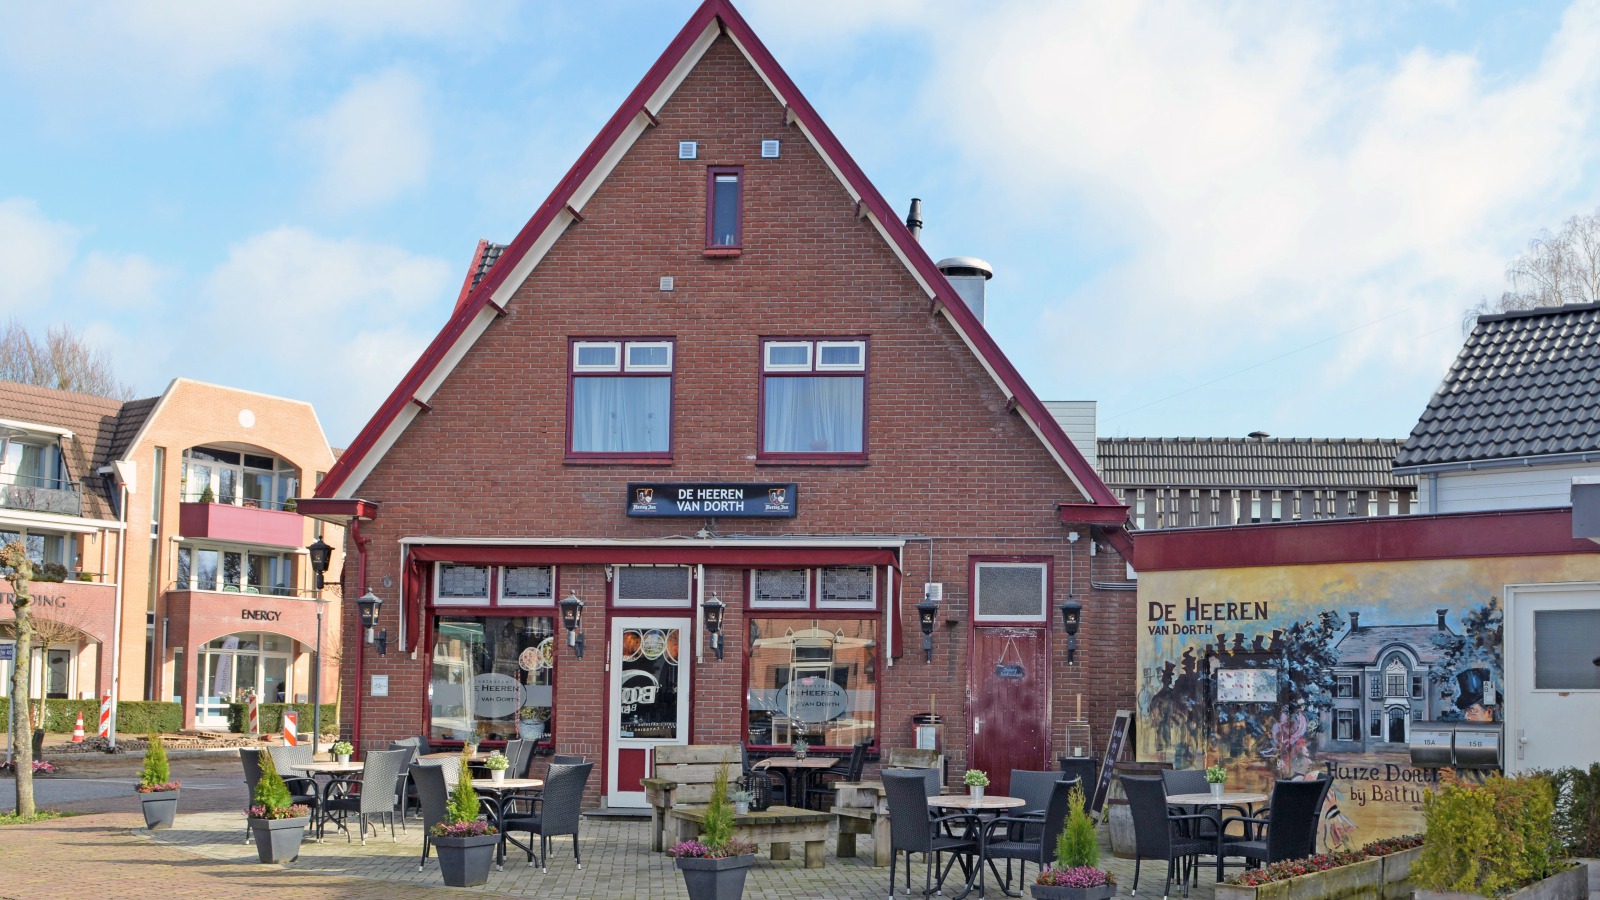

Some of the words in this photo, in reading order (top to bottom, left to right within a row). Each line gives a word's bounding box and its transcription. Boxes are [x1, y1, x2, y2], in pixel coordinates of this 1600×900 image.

[678, 488, 694, 500] DE
[697, 488, 744, 500] HEEREN
[676, 501, 700, 512] VAN
[703, 501, 744, 512] DORTH
[0, 592, 67, 608] TRDING
[241, 608, 282, 621] ENERGY
[1148, 601, 1177, 622] DE
[1186, 597, 1268, 621] HEEREN
[1148, 625, 1169, 635] VAN
[1172, 623, 1213, 635] DORTH
[481, 684, 519, 692] HEEREN
[1350, 786, 1366, 806] bij
[1371, 784, 1425, 802] Battu
